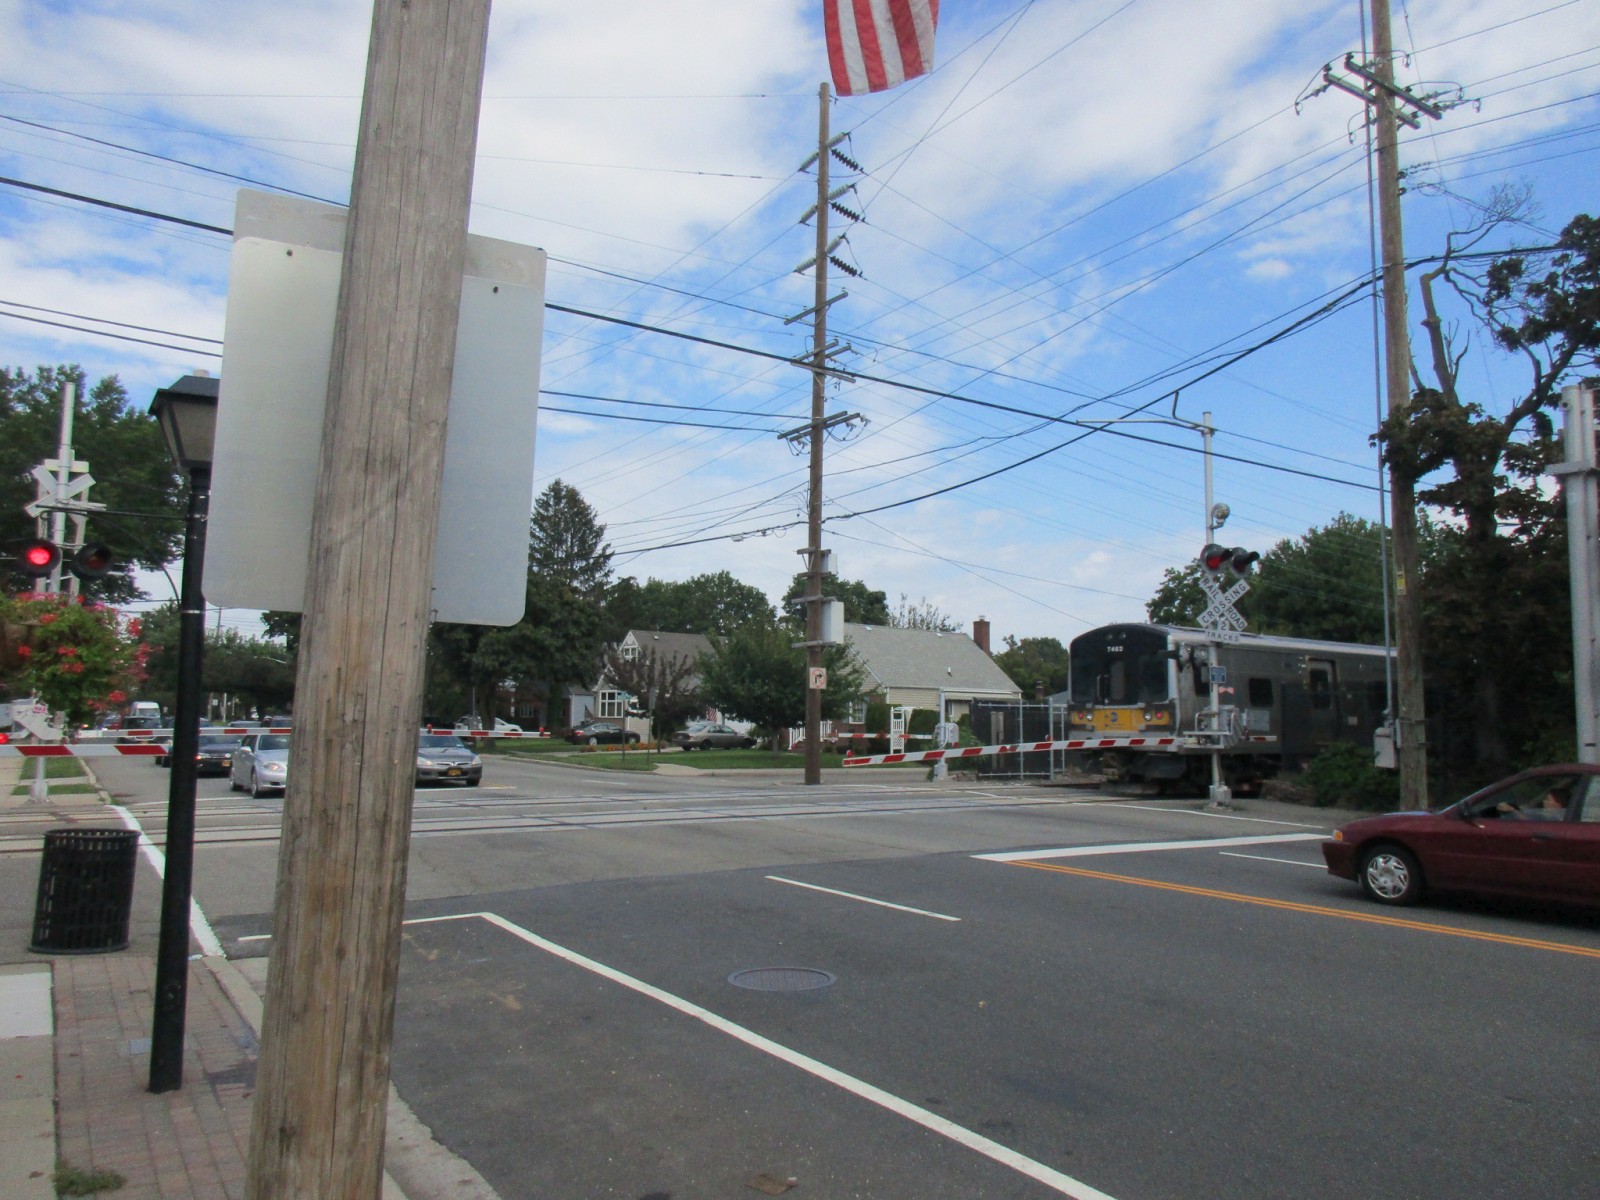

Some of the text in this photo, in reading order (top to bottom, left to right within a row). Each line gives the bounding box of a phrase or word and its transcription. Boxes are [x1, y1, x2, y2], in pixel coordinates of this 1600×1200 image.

[1201, 583, 1246, 624] CROSSING
[1202, 577, 1246, 630] RAIL ROAD
[1206, 631, 1240, 642] TRACKS
[1220, 621, 1227, 631] 2
